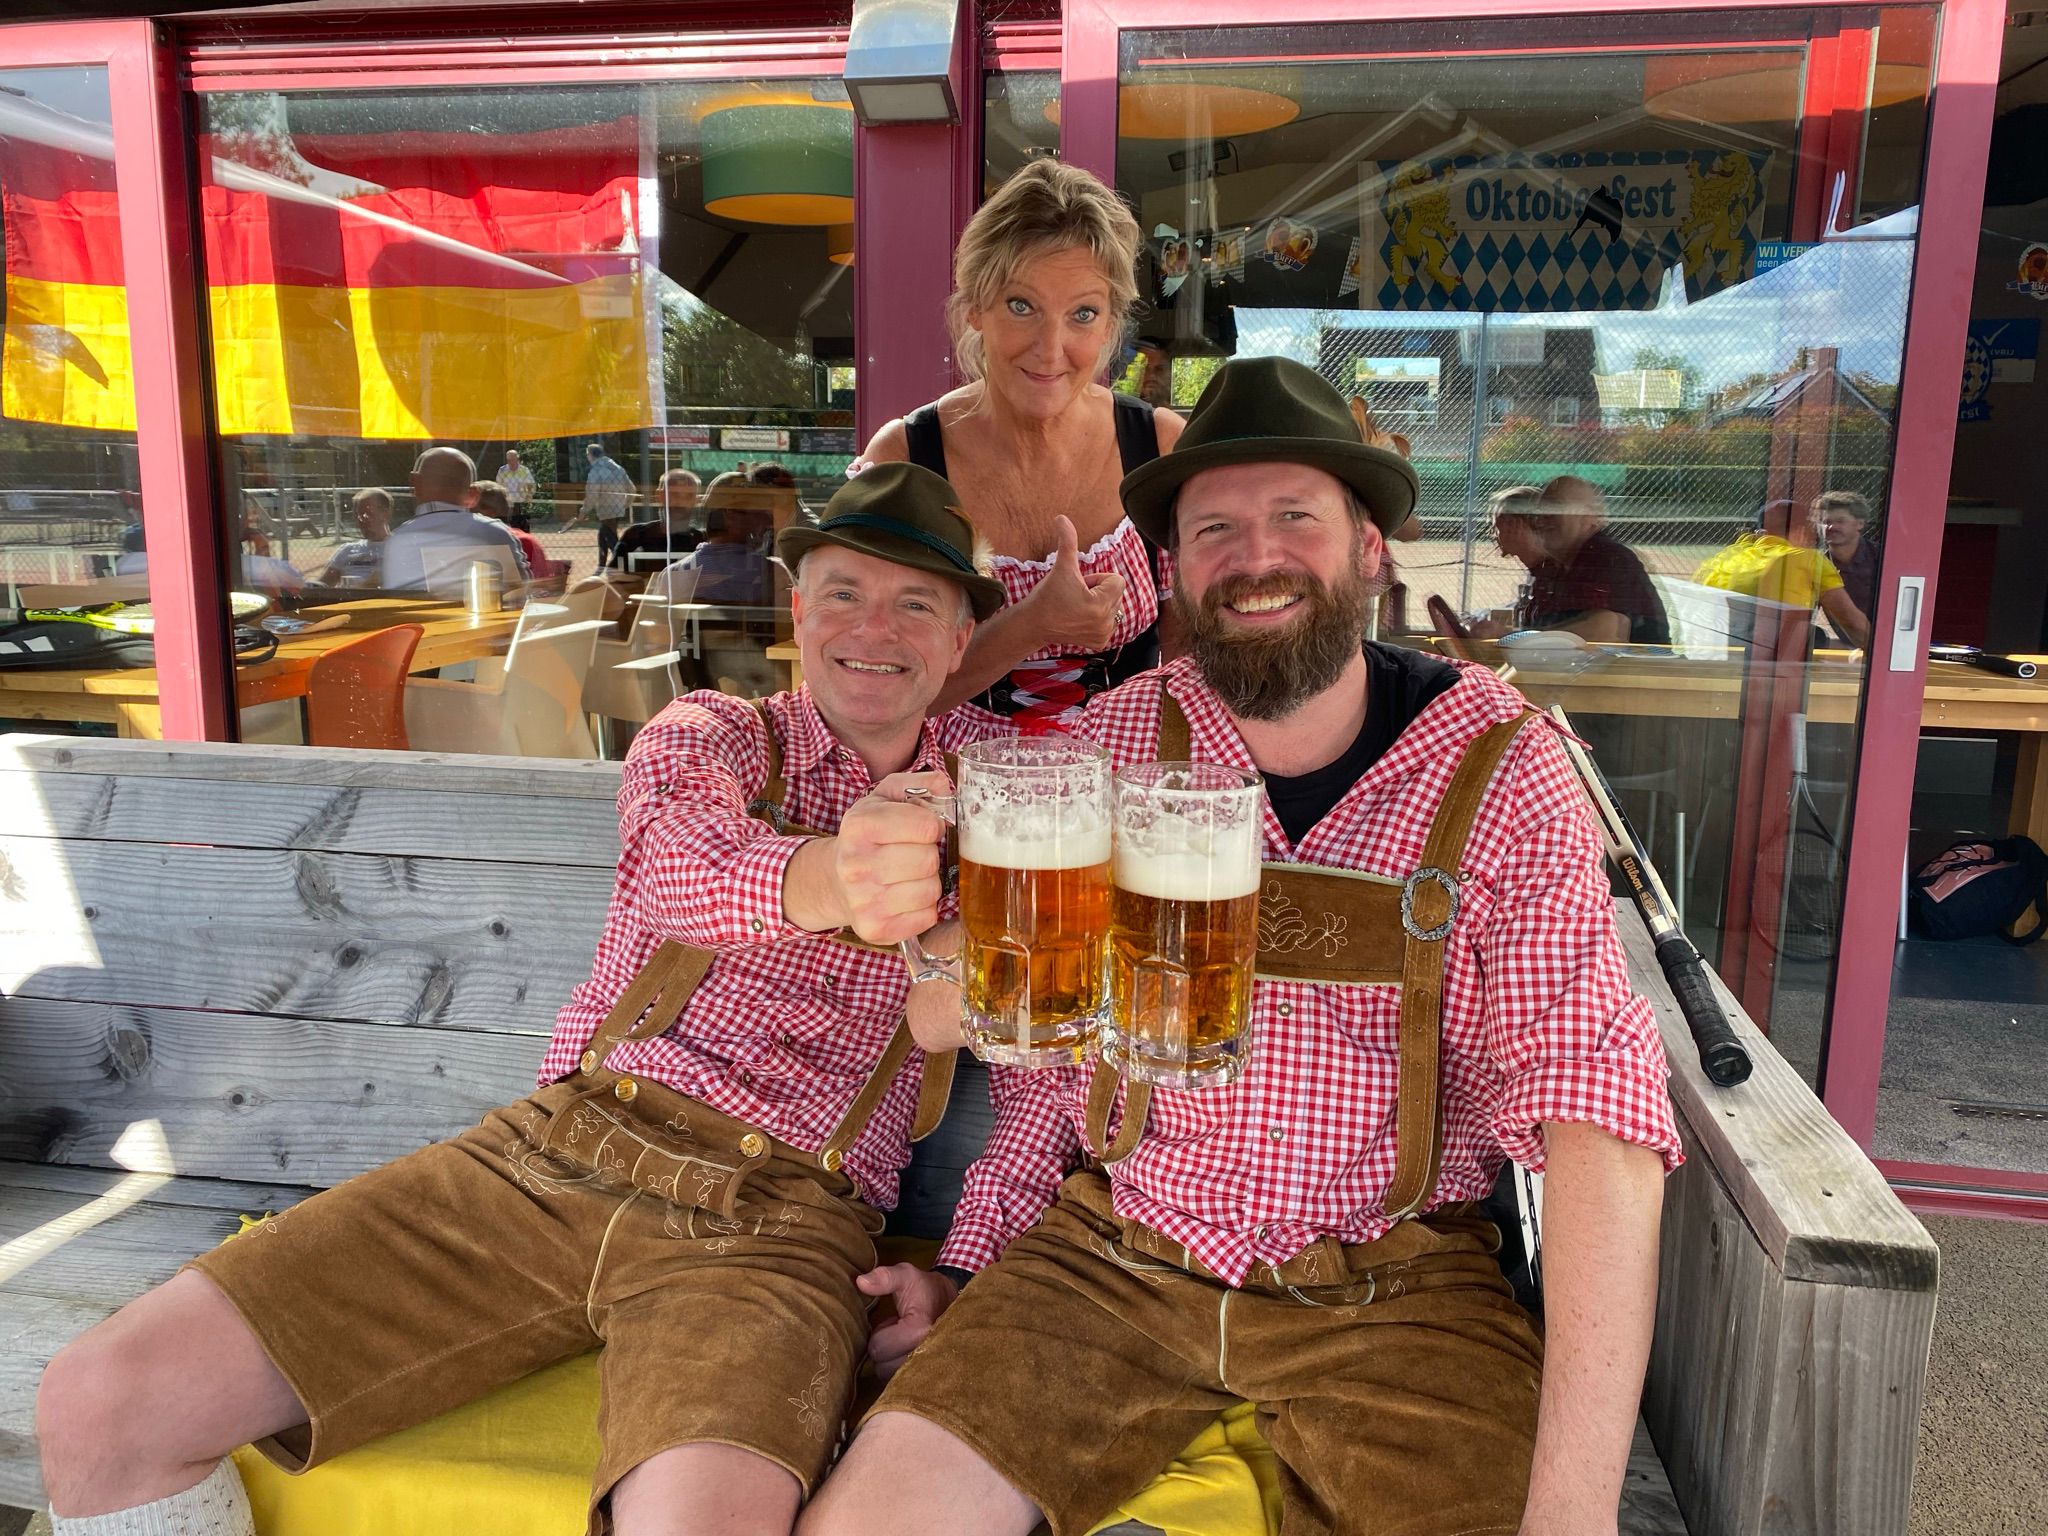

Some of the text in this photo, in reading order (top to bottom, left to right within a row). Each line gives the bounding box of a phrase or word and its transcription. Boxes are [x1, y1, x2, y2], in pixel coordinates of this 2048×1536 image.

[1466, 174, 1676, 222] Oktobefest
[1758, 246, 1778, 258] WIJ
[1757, 260, 1779, 268] geen
[1945, 654, 1977, 663] HEAD
[1622, 856, 1644, 892] Wilson
